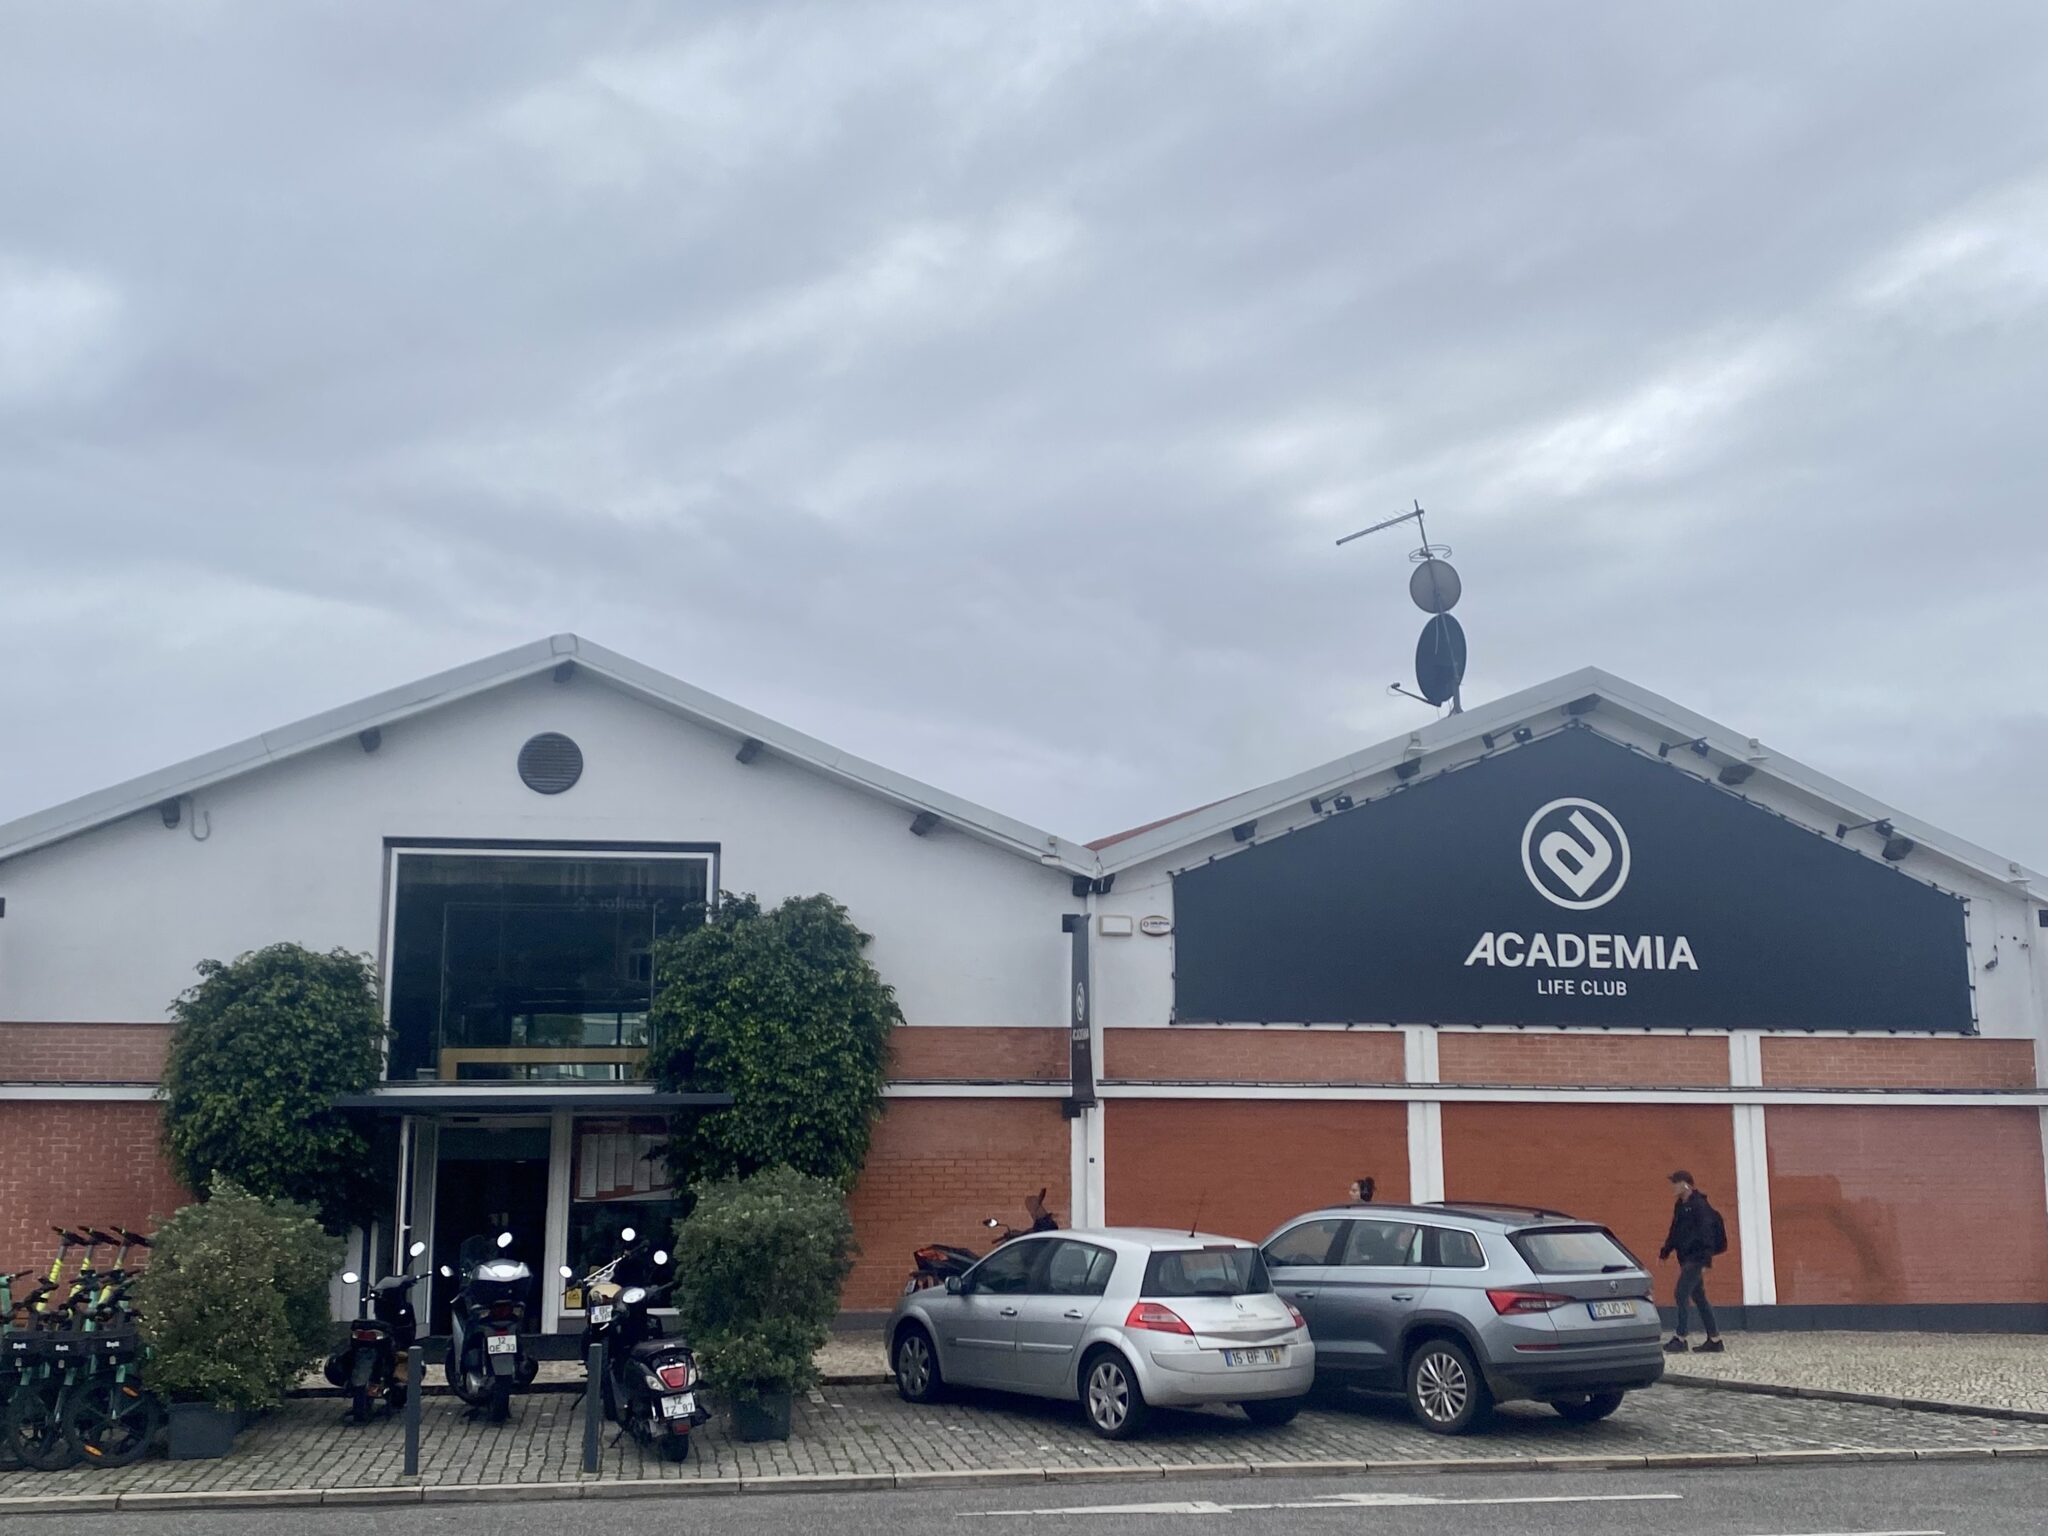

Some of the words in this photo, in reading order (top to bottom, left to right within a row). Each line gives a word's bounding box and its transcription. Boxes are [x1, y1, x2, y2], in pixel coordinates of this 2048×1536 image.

[1464, 931, 1699, 970] ACADEMIA
[1537, 979, 1576, 995] LIFE
[1581, 980, 1628, 996] CLUB
